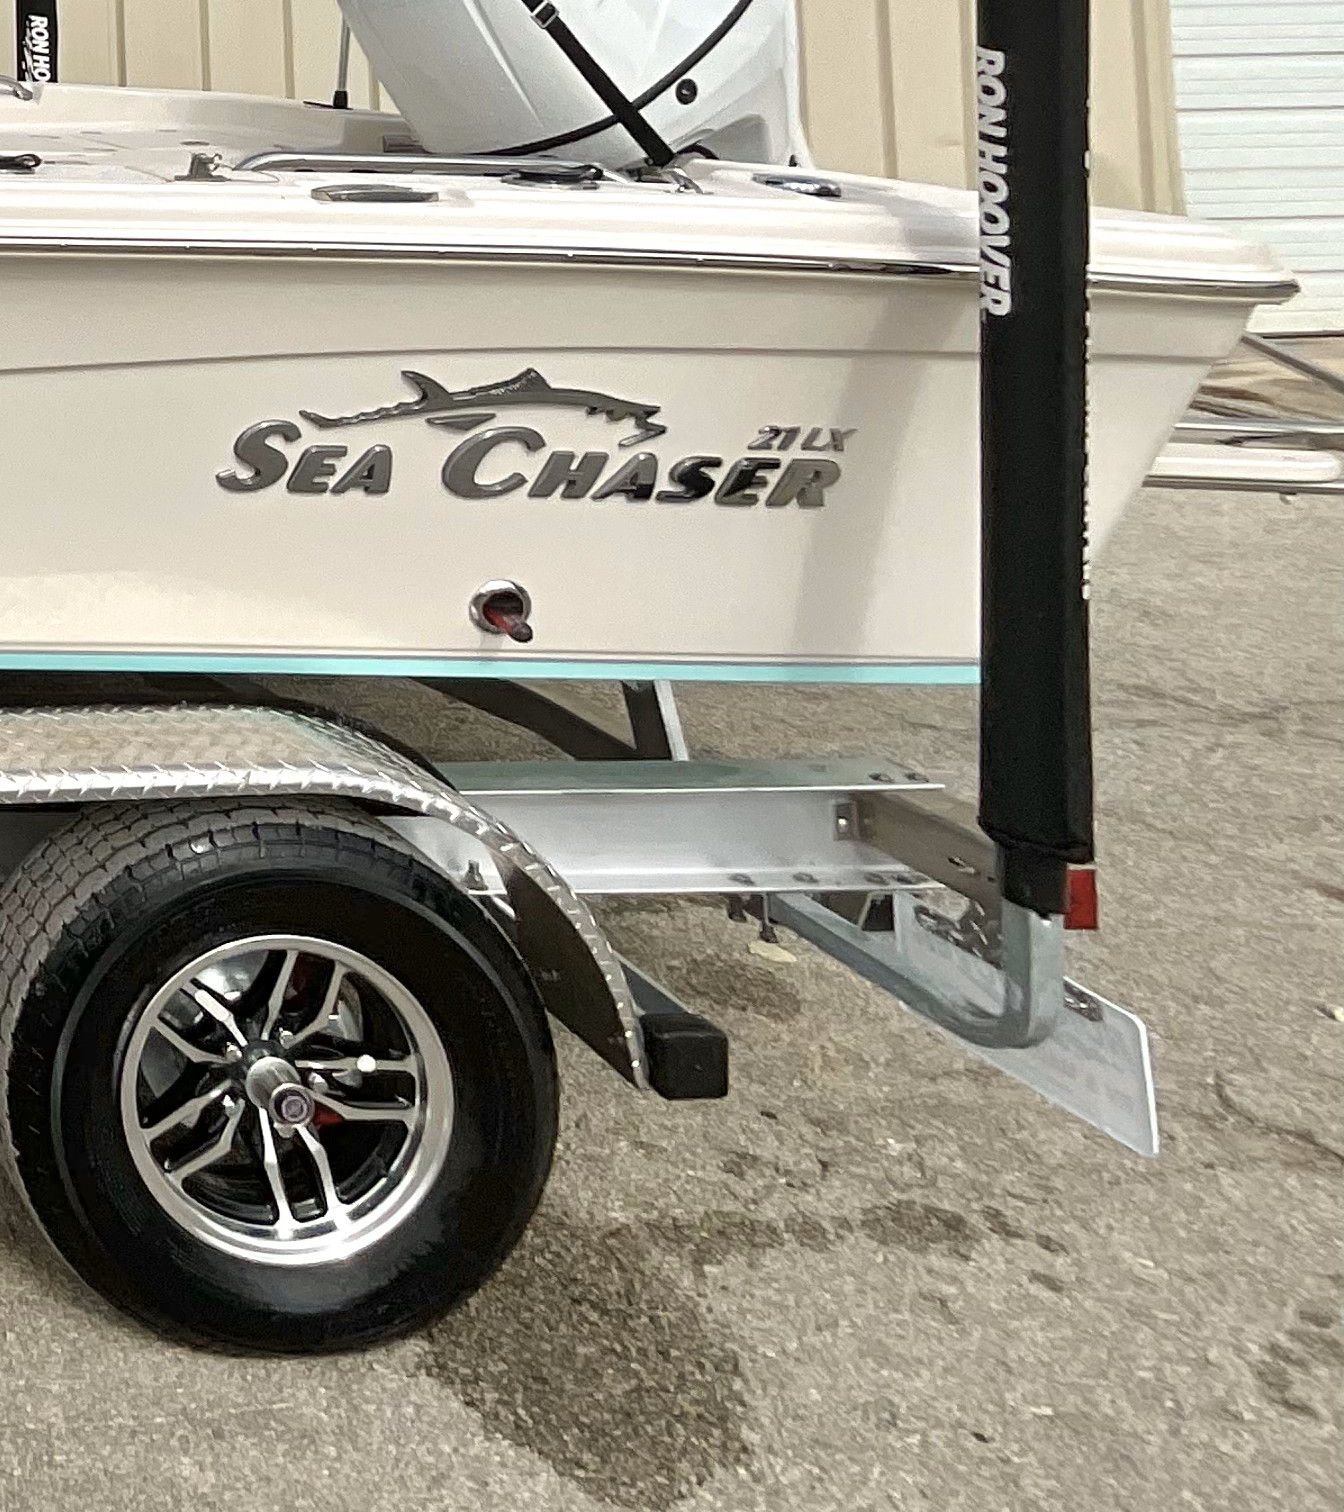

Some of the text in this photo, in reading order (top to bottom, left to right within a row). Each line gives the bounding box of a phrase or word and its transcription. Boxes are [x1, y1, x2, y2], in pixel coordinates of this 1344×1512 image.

[28, 14, 50, 55] RON
[977, 46, 1012, 317] RON HOOVER
[215, 419, 842, 508] SEA CHASER
